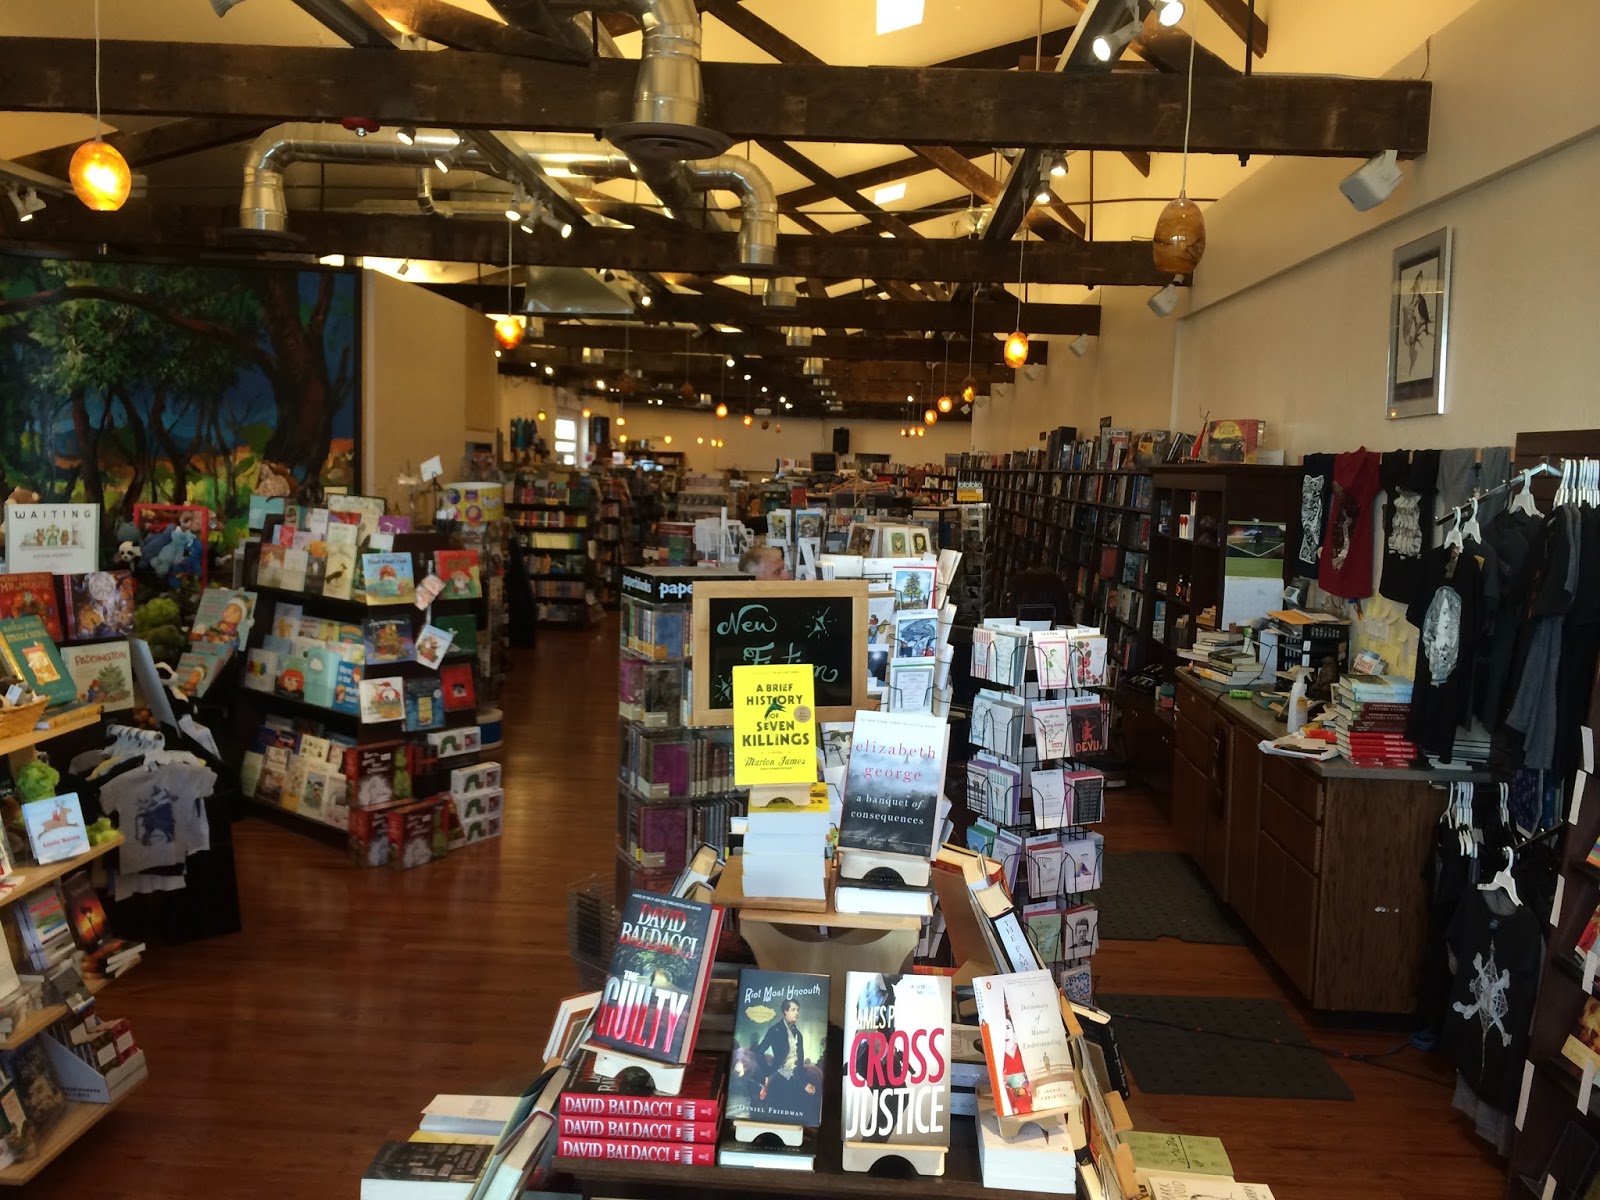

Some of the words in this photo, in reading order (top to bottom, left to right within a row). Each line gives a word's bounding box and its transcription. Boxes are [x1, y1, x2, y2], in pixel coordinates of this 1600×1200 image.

[15, 509, 91, 519] WAITING
[659, 582, 693, 599] pape
[716, 604, 777, 635] New
[75, 651, 126, 666] PADDINGTON
[756, 684, 763, 692] A
[766, 683, 793, 692] BRIEF
[746, 694, 803, 706] HISTORY
[757, 721, 795, 732] SEVEN
[742, 733, 810, 747] KILLINGS
[856, 740, 935, 759] elizabeth
[778, 755, 806, 767] James
[864, 766, 922, 783] george
[866, 794, 908, 809] banquet
[912, 799, 924, 809] of
[850, 810, 924, 825] consequences
[43, 838, 61, 849] Little
[61, 834, 81, 845] Santa
[637, 903, 687, 933] DAVID
[1002, 920, 1017, 943] THE
[619, 922, 698, 959] BALDACCI
[623, 970, 640, 982] THE
[744, 988, 762, 1003] Riot
[763, 986, 784, 1002] Most
[786, 983, 821, 1001] Uncouth
[595, 976, 689, 1053] GUILTY
[1021, 1003, 1048, 1012] Dictionary
[855, 1005, 886, 1030] AMES
[1031, 1028, 1050, 1036] Mutual
[1022, 1040, 1062, 1050] Understanding
[849, 1028, 945, 1088] CROSS
[565, 1097, 605, 1114] DAVID
[608, 1099, 672, 1117] BALDACCI
[739, 1104, 765, 1114] DANIEL
[768, 1106, 804, 1117] FRIEDMAN
[845, 1085, 945, 1138] JUSTICE
[564, 1119, 604, 1136] DAVID
[608, 1121, 672, 1139] BALDACCI
[563, 1141, 603, 1158] DAVID
[606, 1143, 670, 1162] BALDACCI
